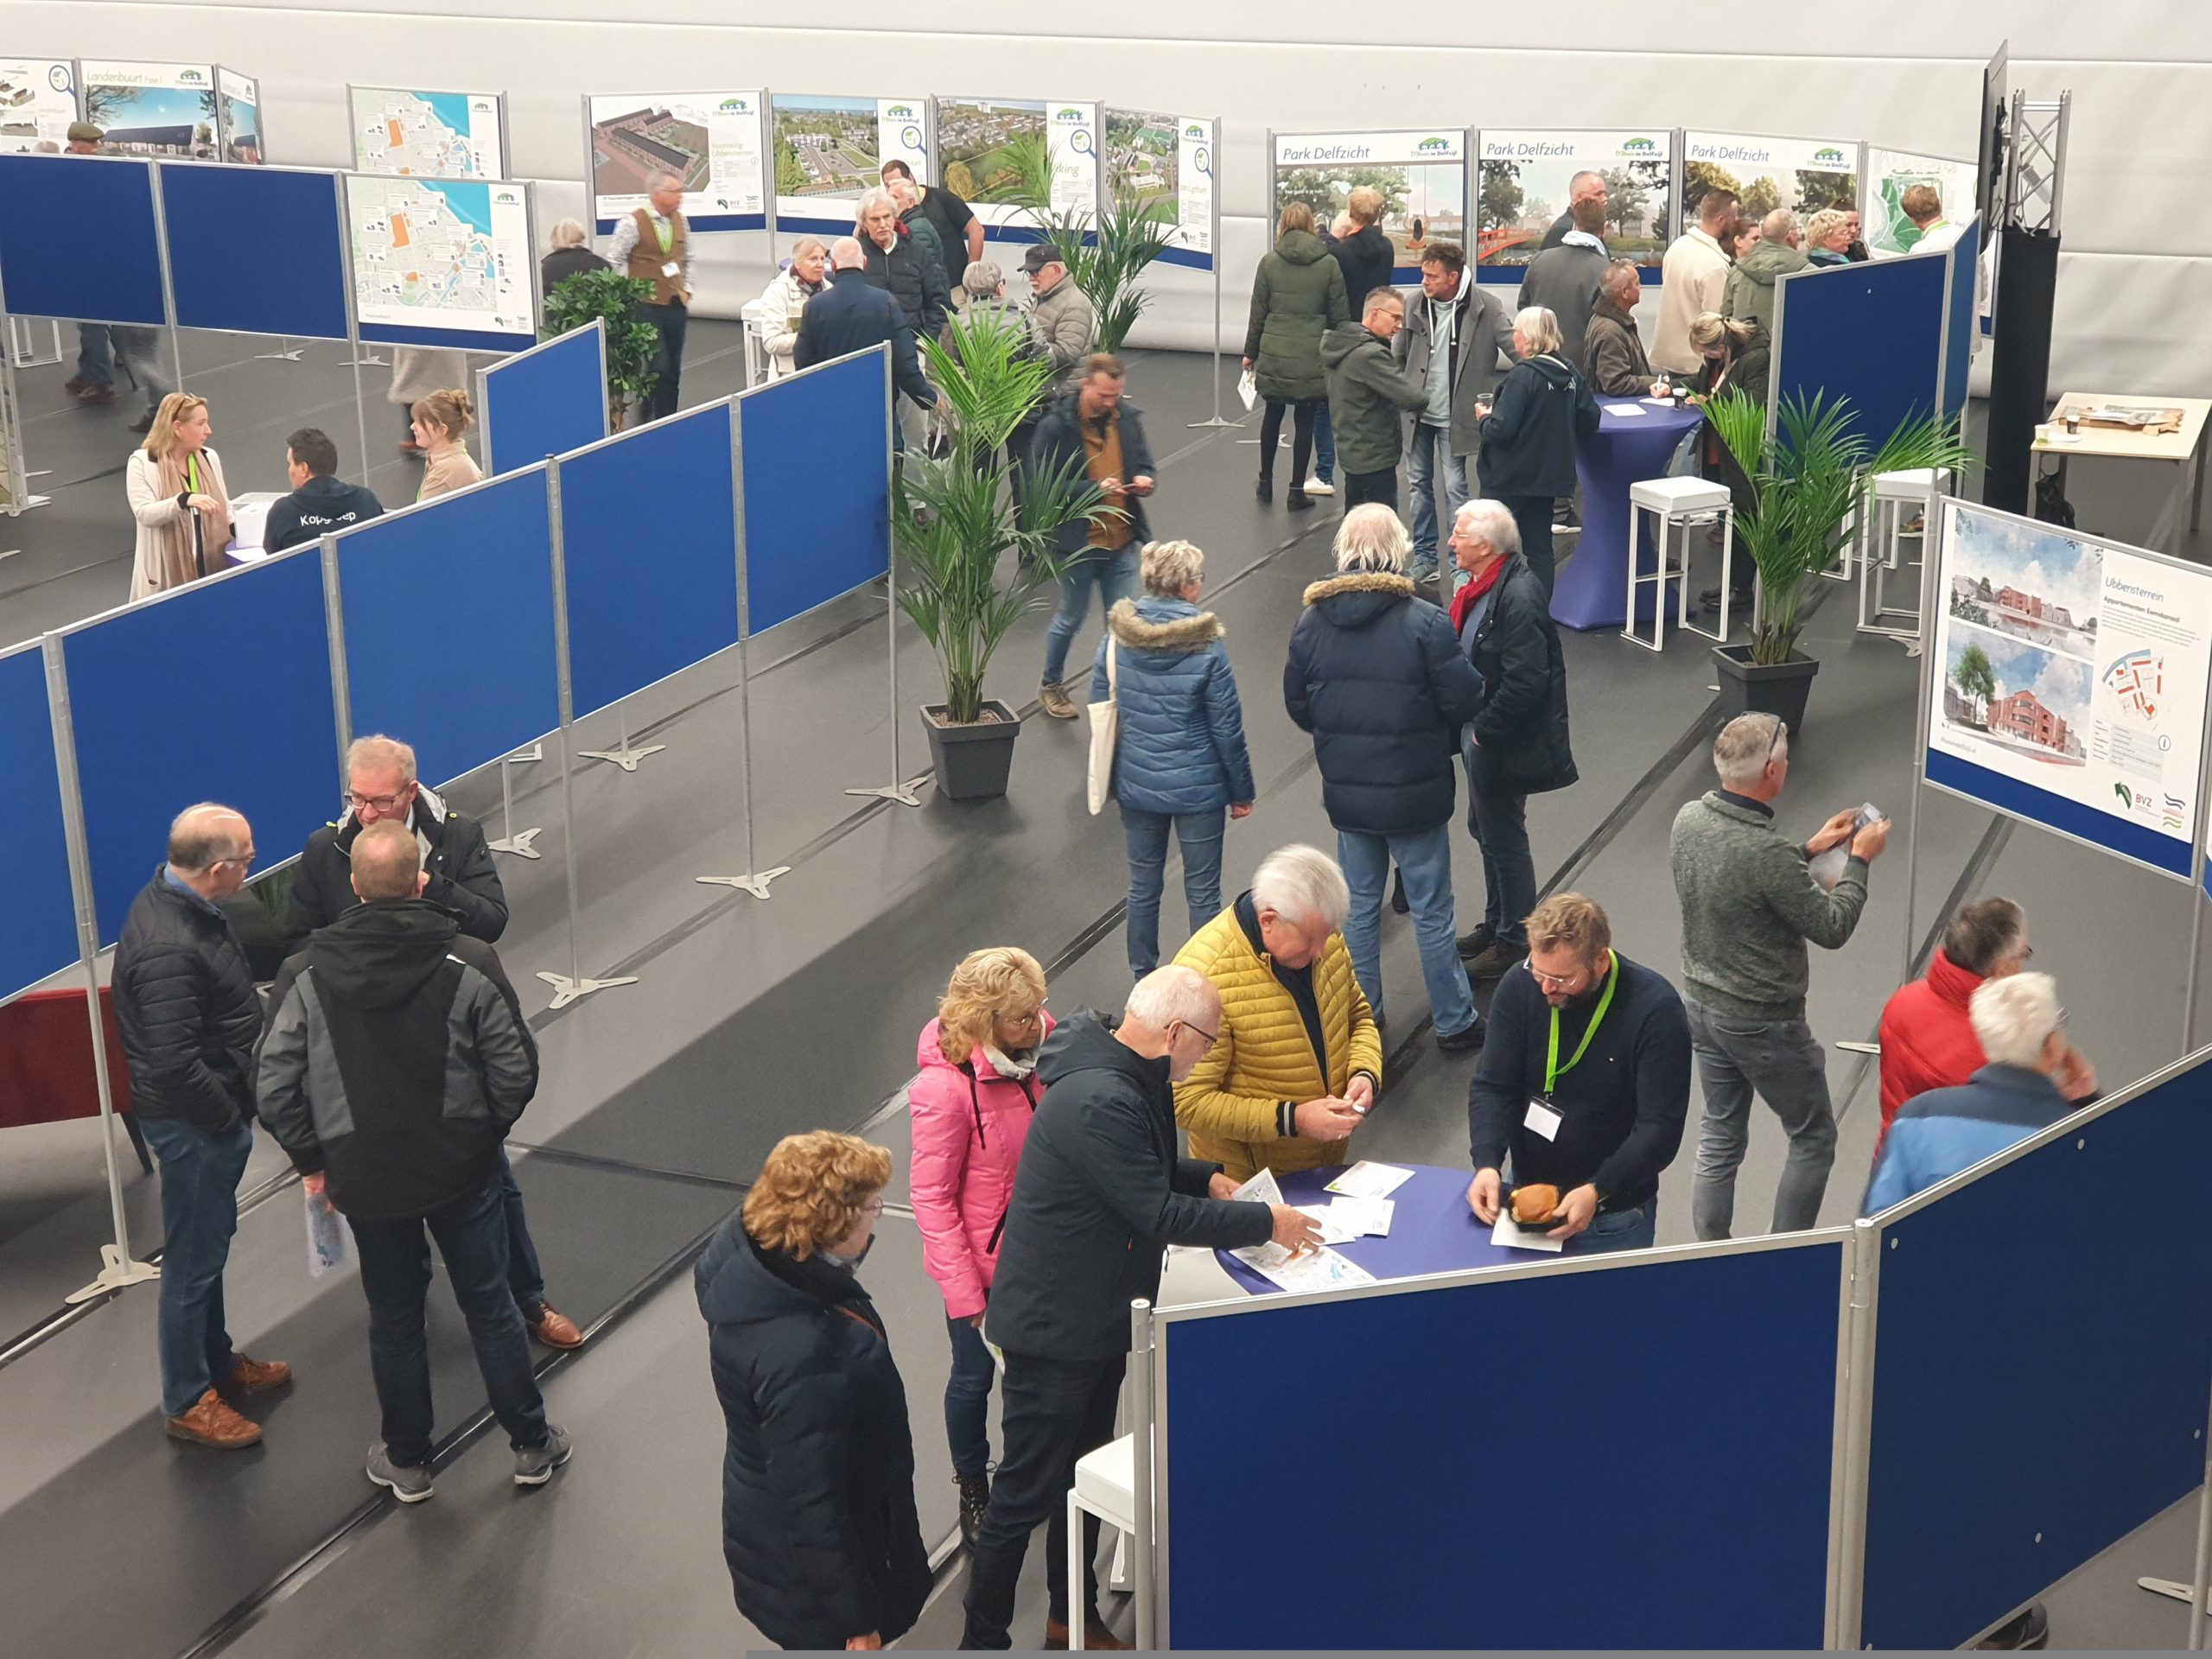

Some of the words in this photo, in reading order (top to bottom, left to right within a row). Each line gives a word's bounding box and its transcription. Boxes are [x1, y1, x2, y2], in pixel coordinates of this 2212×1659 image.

[86, 68, 143, 84] Landenbuurt
[1283, 146, 1311, 161] Park
[1314, 144, 1370, 160] Delfzicht
[1487, 143, 1515, 156] Park
[1517, 142, 1575, 156] Delfzicht
[1691, 144, 1716, 159] Park
[1719, 146, 1770, 162] Delfzicht
[2105, 575, 2164, 603] Ubbensterrein
[2135, 793, 2152, 808] BVZ
